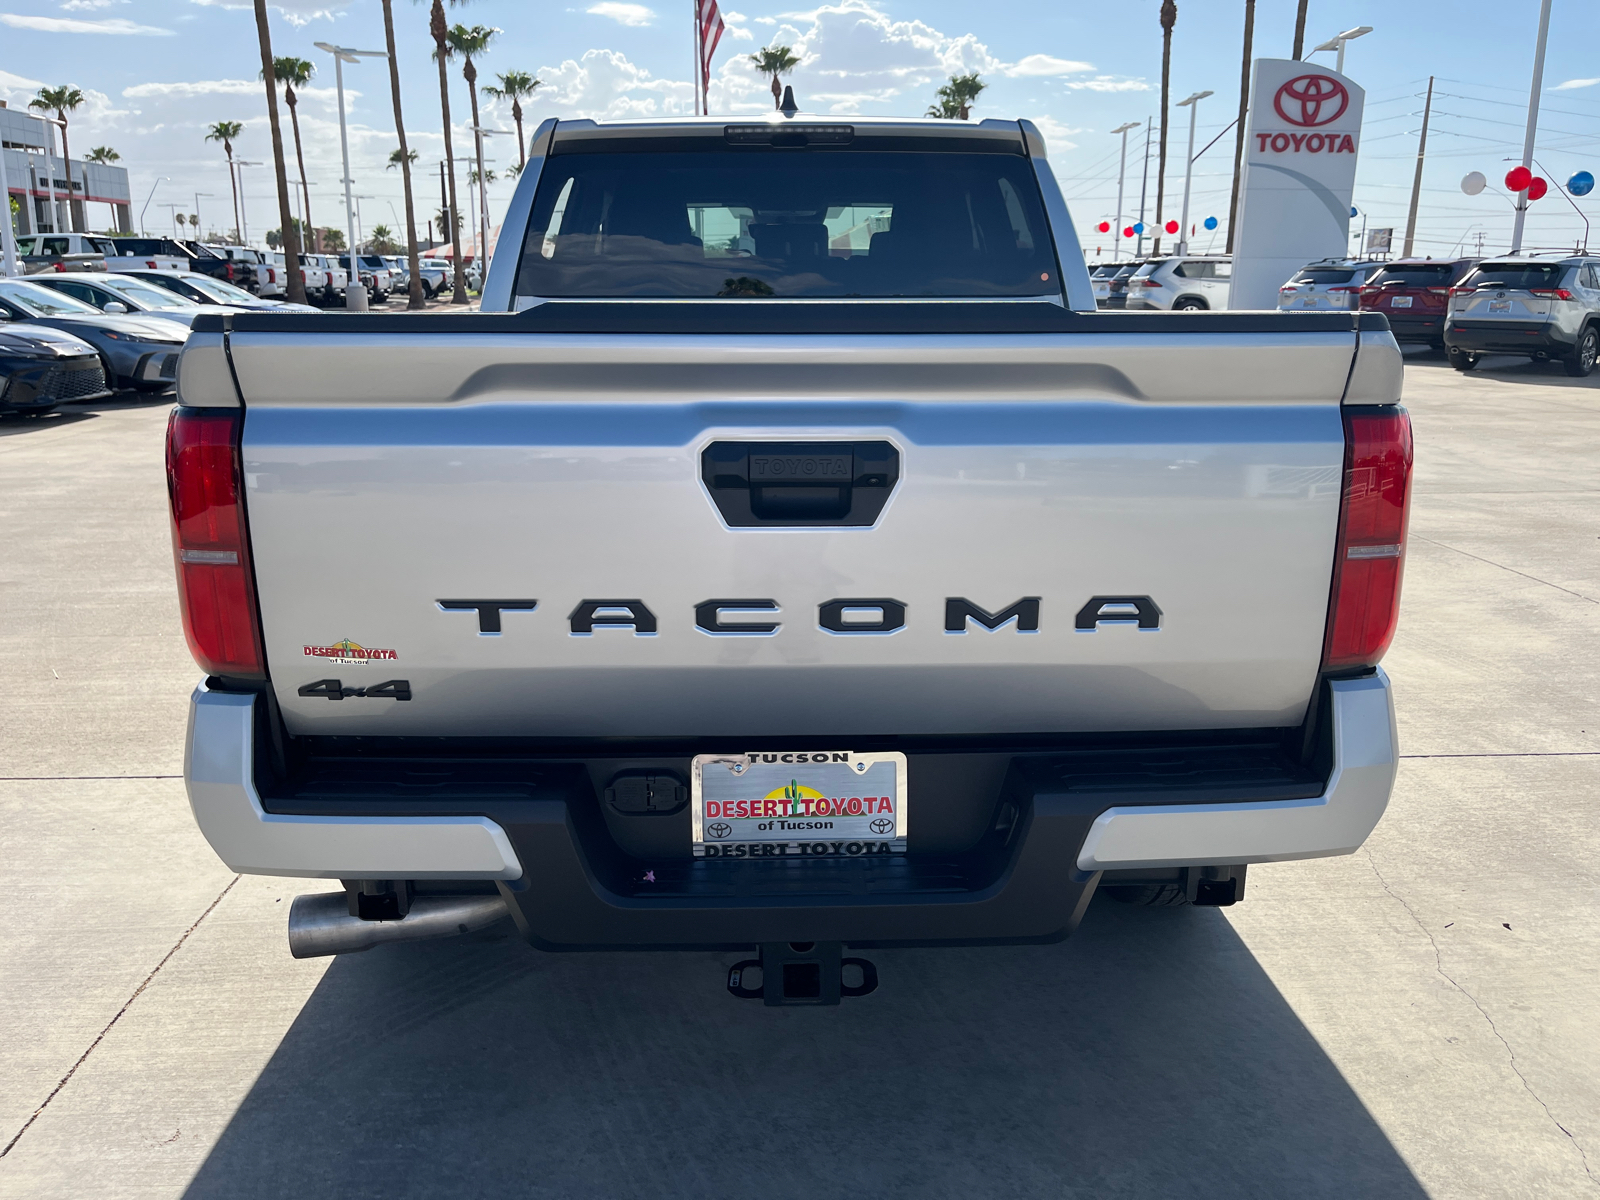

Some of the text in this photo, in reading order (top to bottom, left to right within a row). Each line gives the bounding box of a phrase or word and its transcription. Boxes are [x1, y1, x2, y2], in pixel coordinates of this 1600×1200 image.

[1256, 133, 1355, 154] TOYOTA
[755, 458, 848, 475] TOYOTA
[435, 595, 1163, 637] TACOMA
[303, 646, 397, 660] DESERT TOYOTA
[747, 752, 849, 764] TUCSON
[706, 796, 894, 819] DESERT TOYOTA
[757, 820, 834, 831] of Tucson
[704, 841, 893, 858] DESERT TOYOTA
